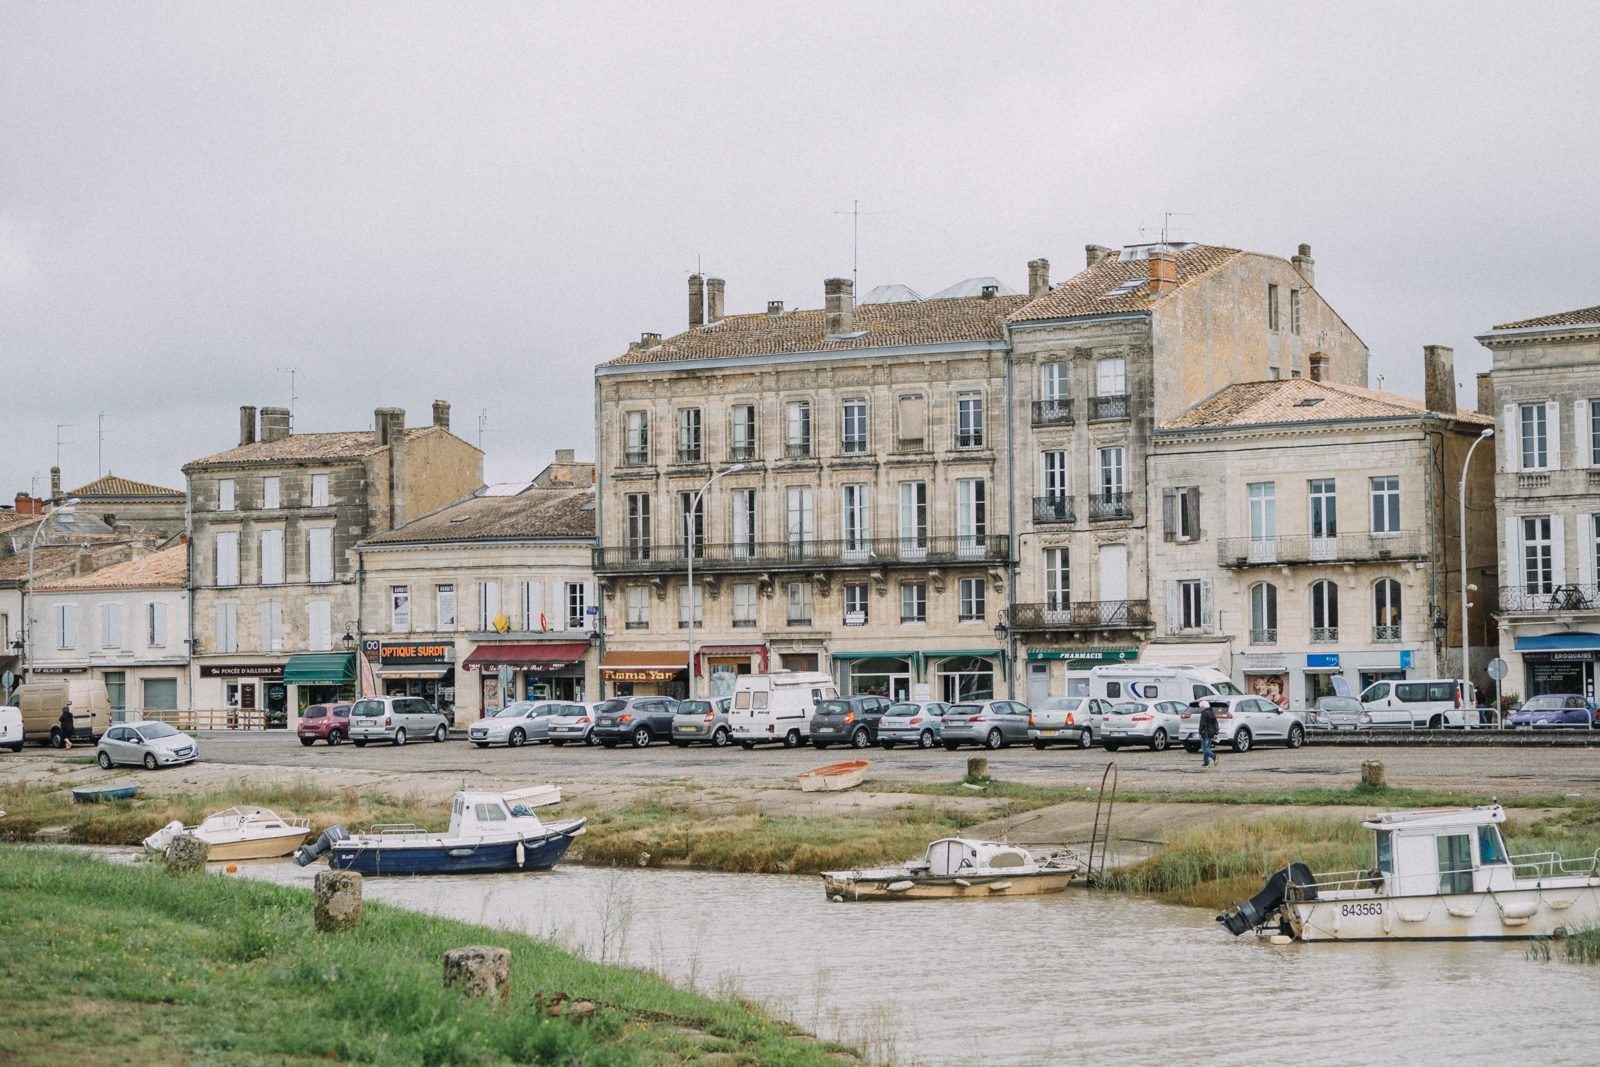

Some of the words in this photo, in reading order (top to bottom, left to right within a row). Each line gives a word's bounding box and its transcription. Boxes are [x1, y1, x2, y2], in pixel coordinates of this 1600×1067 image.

[381, 646, 416, 657] OPTIQUE
[417, 645, 447, 657] SURDIT
[1342, 902, 1383, 916] 843563
